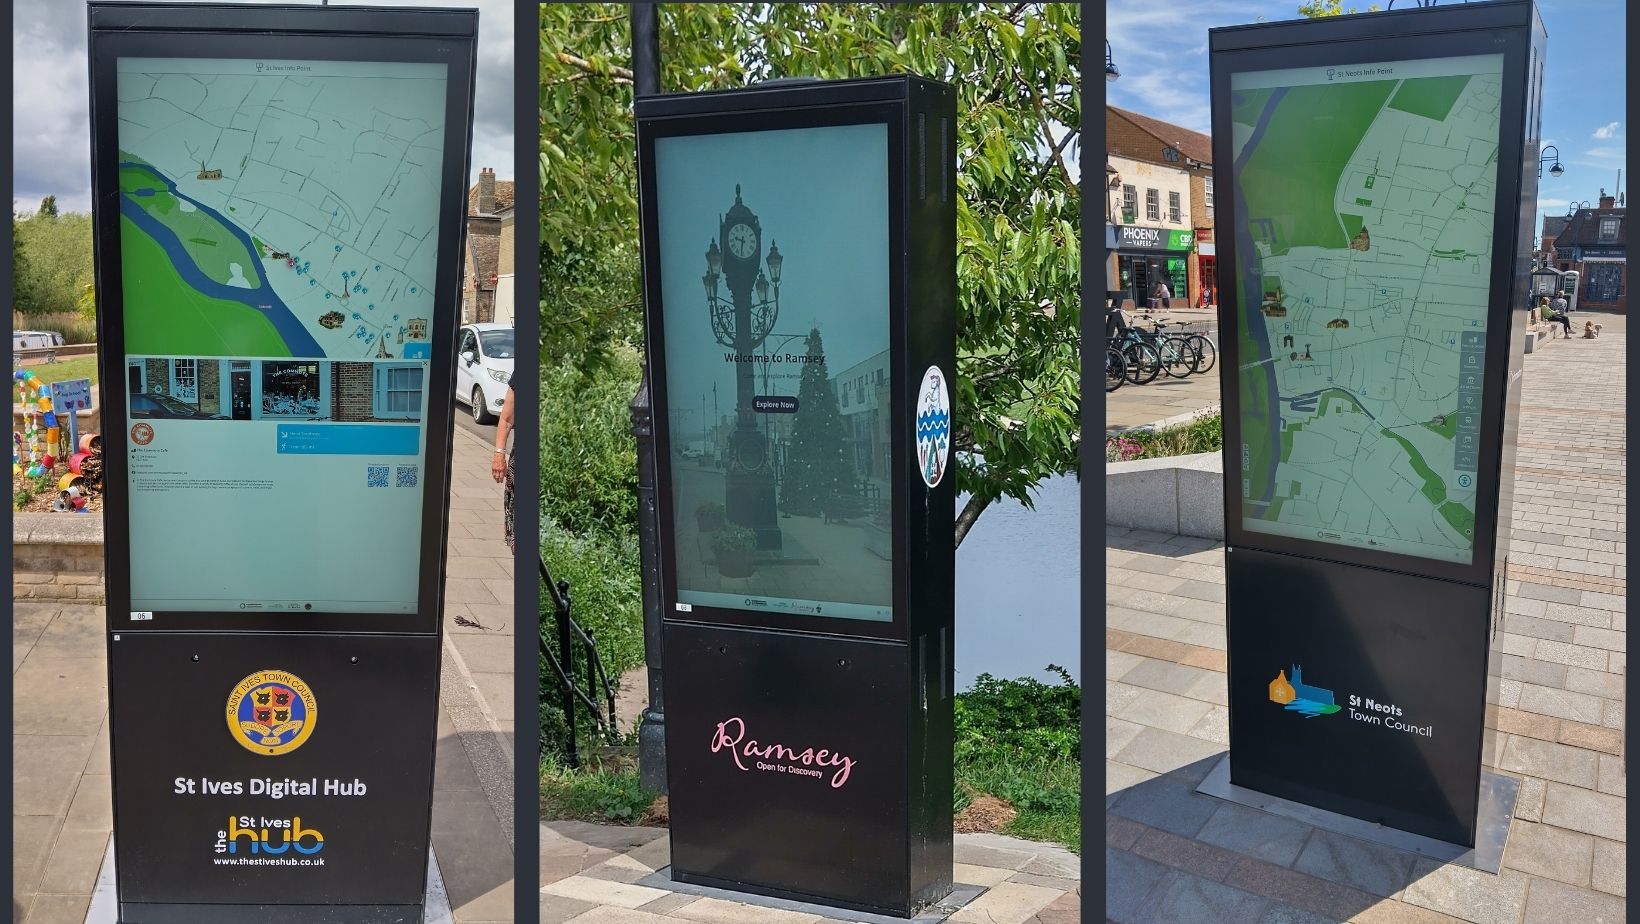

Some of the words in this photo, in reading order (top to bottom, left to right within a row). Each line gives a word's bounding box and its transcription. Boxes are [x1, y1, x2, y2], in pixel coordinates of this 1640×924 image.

[1123, 227, 1160, 241] PHOENIX
[1133, 239, 1152, 247] VAPERS
[724, 353, 770, 363] Welcome
[772, 354, 783, 363] to
[785, 353, 826, 365] Ramsey
[756, 400, 780, 409] Explore
[137, 612, 146, 620] 06
[228, 690, 243, 716] SAINT
[240, 676, 261, 692] IVES
[263, 673, 291, 683] TOWN
[291, 680, 316, 715] COUNCIL
[1349, 694, 1362, 707] St
[1365, 698, 1403, 717] Neots
[1348, 707, 1381, 726] Town
[1384, 716, 1433, 738] Council
[711, 717, 857, 788] Ramsey
[756, 761, 776, 771] Open
[777, 763, 787, 773] for
[788, 765, 823, 779] Discovery
[174, 777, 196, 795] St
[201, 777, 244, 795] Ives
[249, 777, 317, 799] Digital
[324, 778, 368, 797] Hub
[239, 816, 257, 828] St
[260, 816, 292, 828] Ives
[214, 830, 227, 854] the
[229, 815, 325, 856] hub
[213, 857, 326, 867] www.thestiveshub.co.uk
